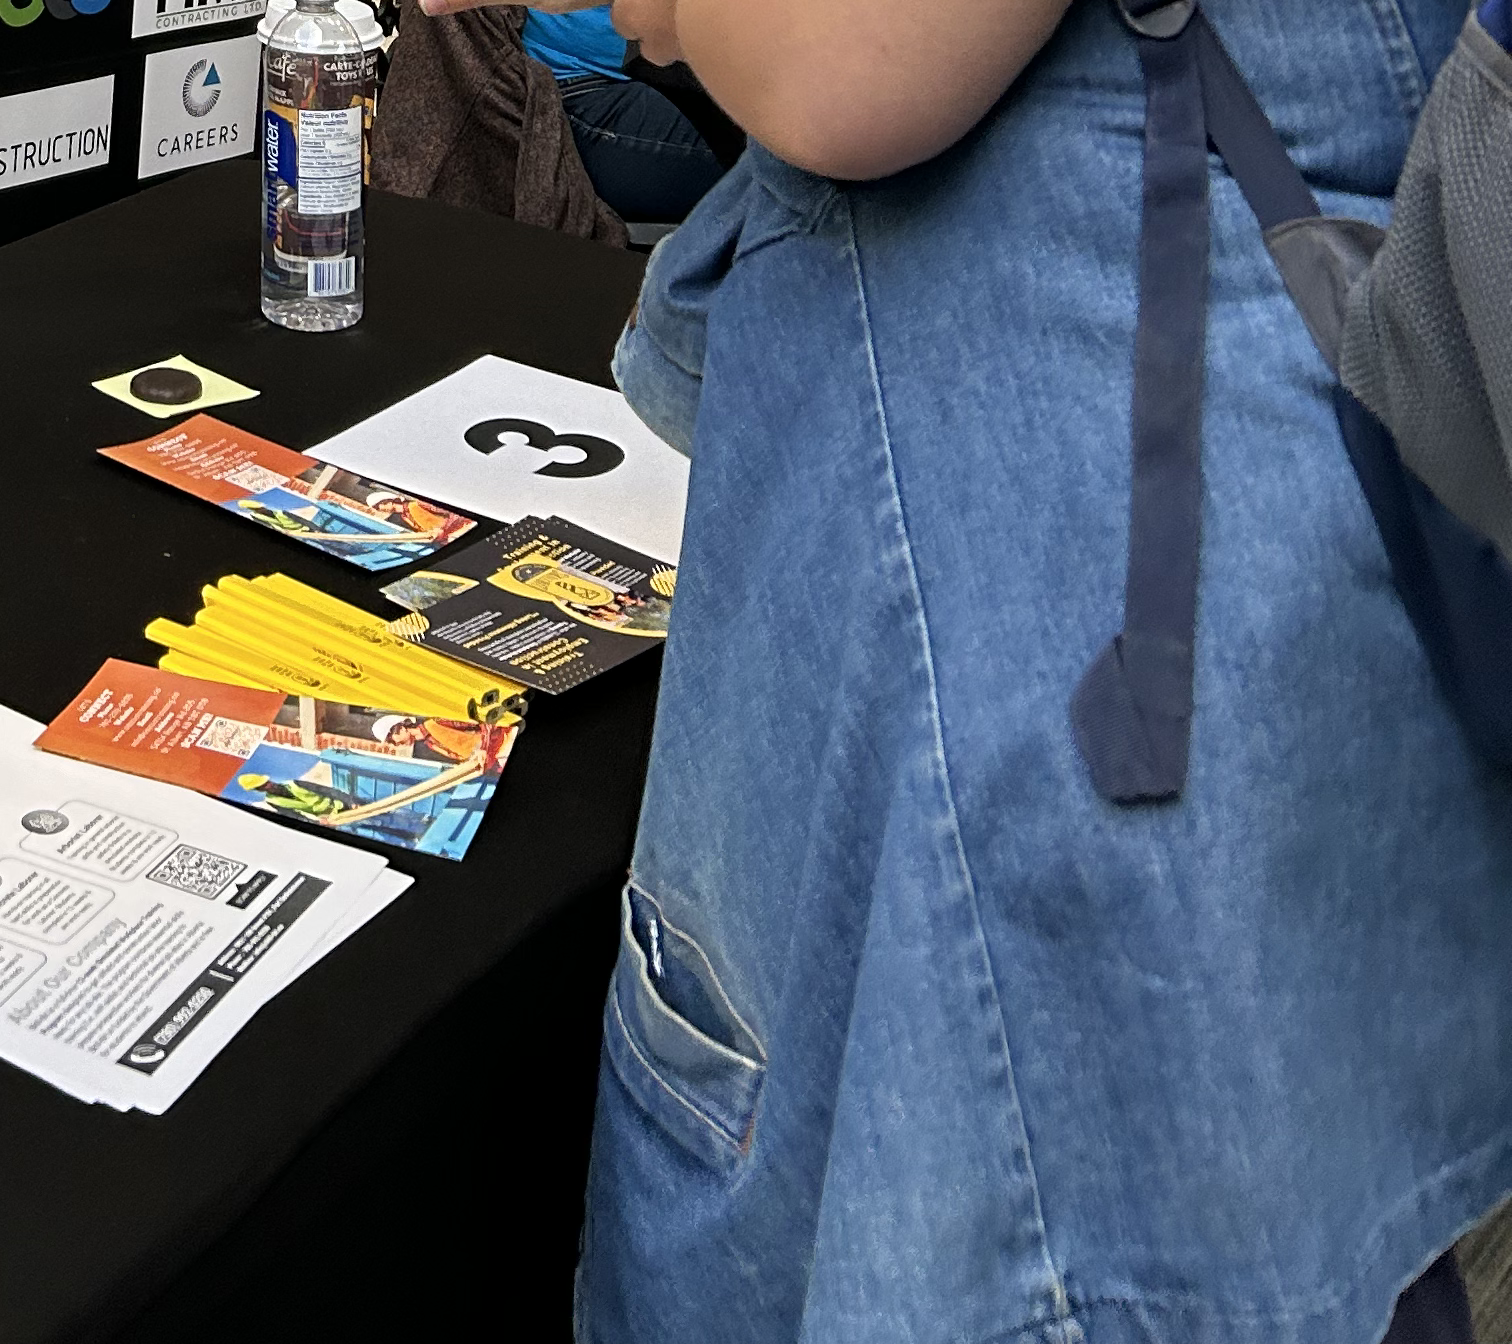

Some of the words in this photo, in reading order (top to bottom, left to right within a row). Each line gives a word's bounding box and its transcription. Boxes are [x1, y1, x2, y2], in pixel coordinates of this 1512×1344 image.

[155, 5, 239, 30] CONTRACTING
[157, 123, 239, 159] CAREERS
[463, 417, 626, 479] 3
